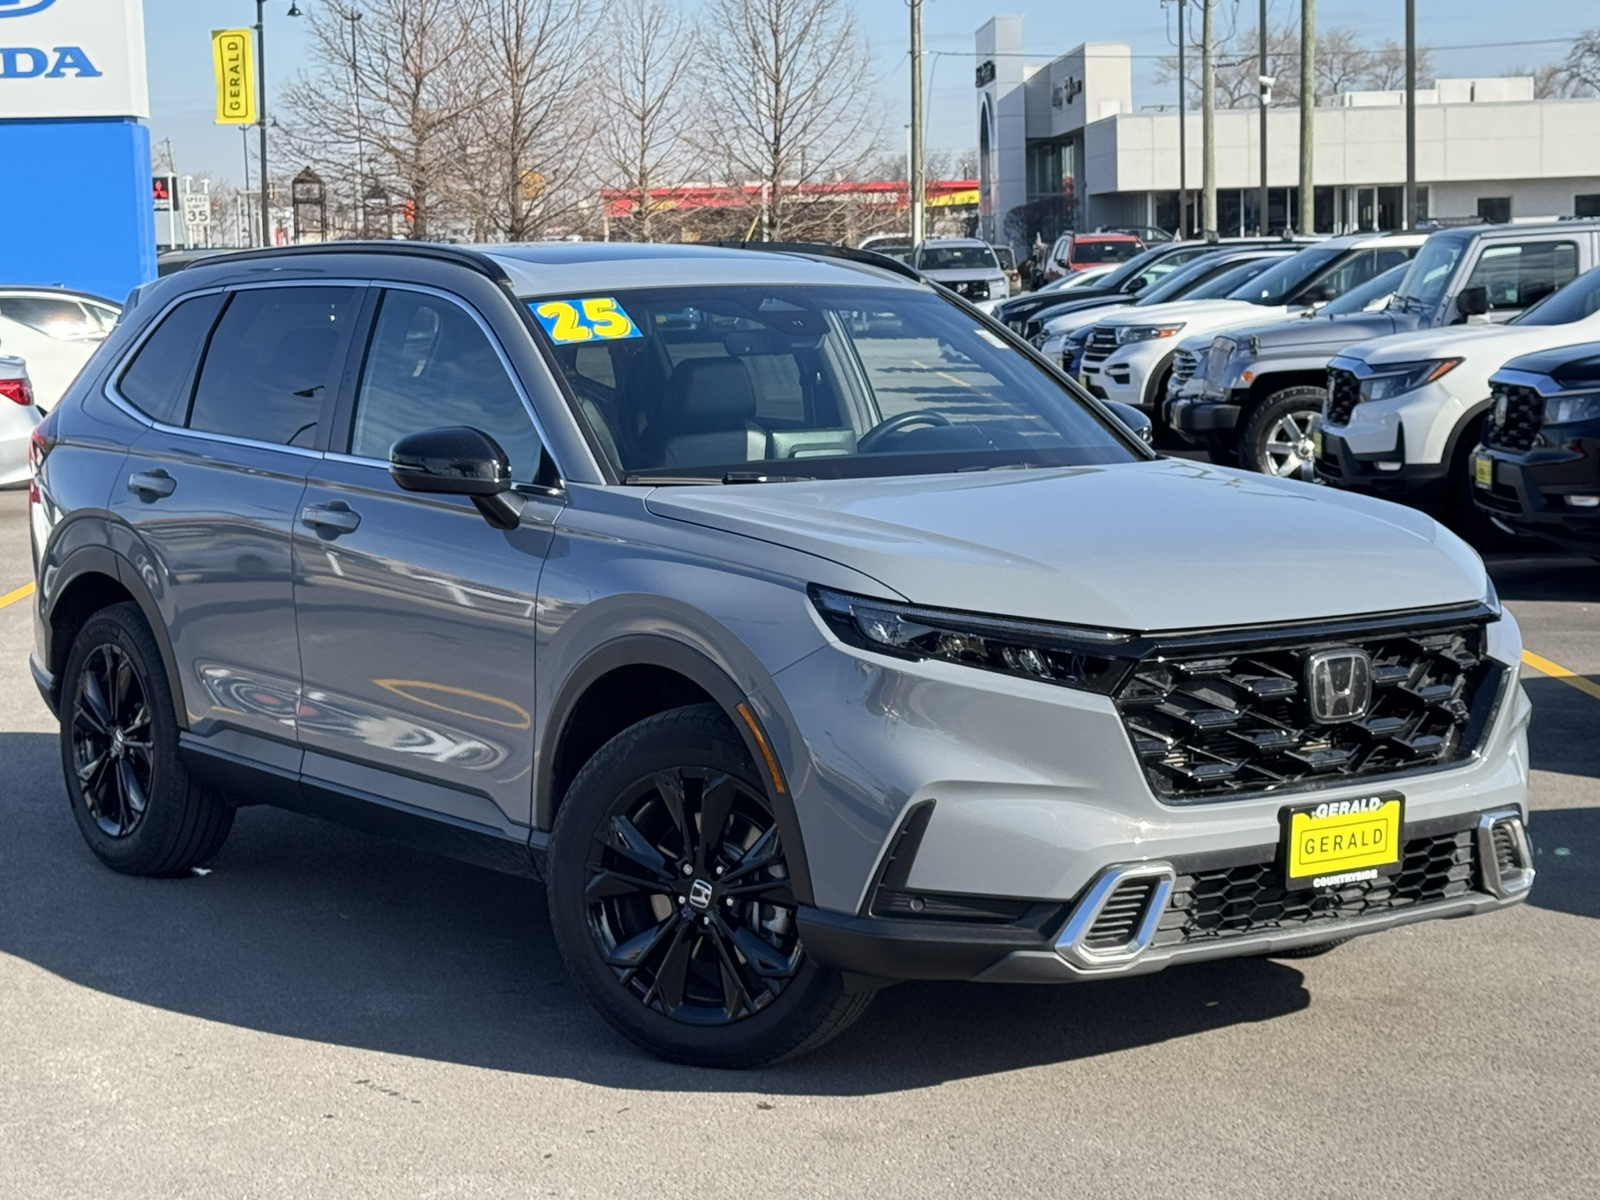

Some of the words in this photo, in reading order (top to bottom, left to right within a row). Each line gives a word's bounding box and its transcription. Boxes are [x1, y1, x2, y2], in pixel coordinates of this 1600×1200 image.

[227, 42, 241, 111] GERALD
[187, 210, 208, 222] 35
[537, 298, 633, 341] 25
[1315, 797, 1381, 818] GERALD
[1304, 828, 1383, 855] GERALD
